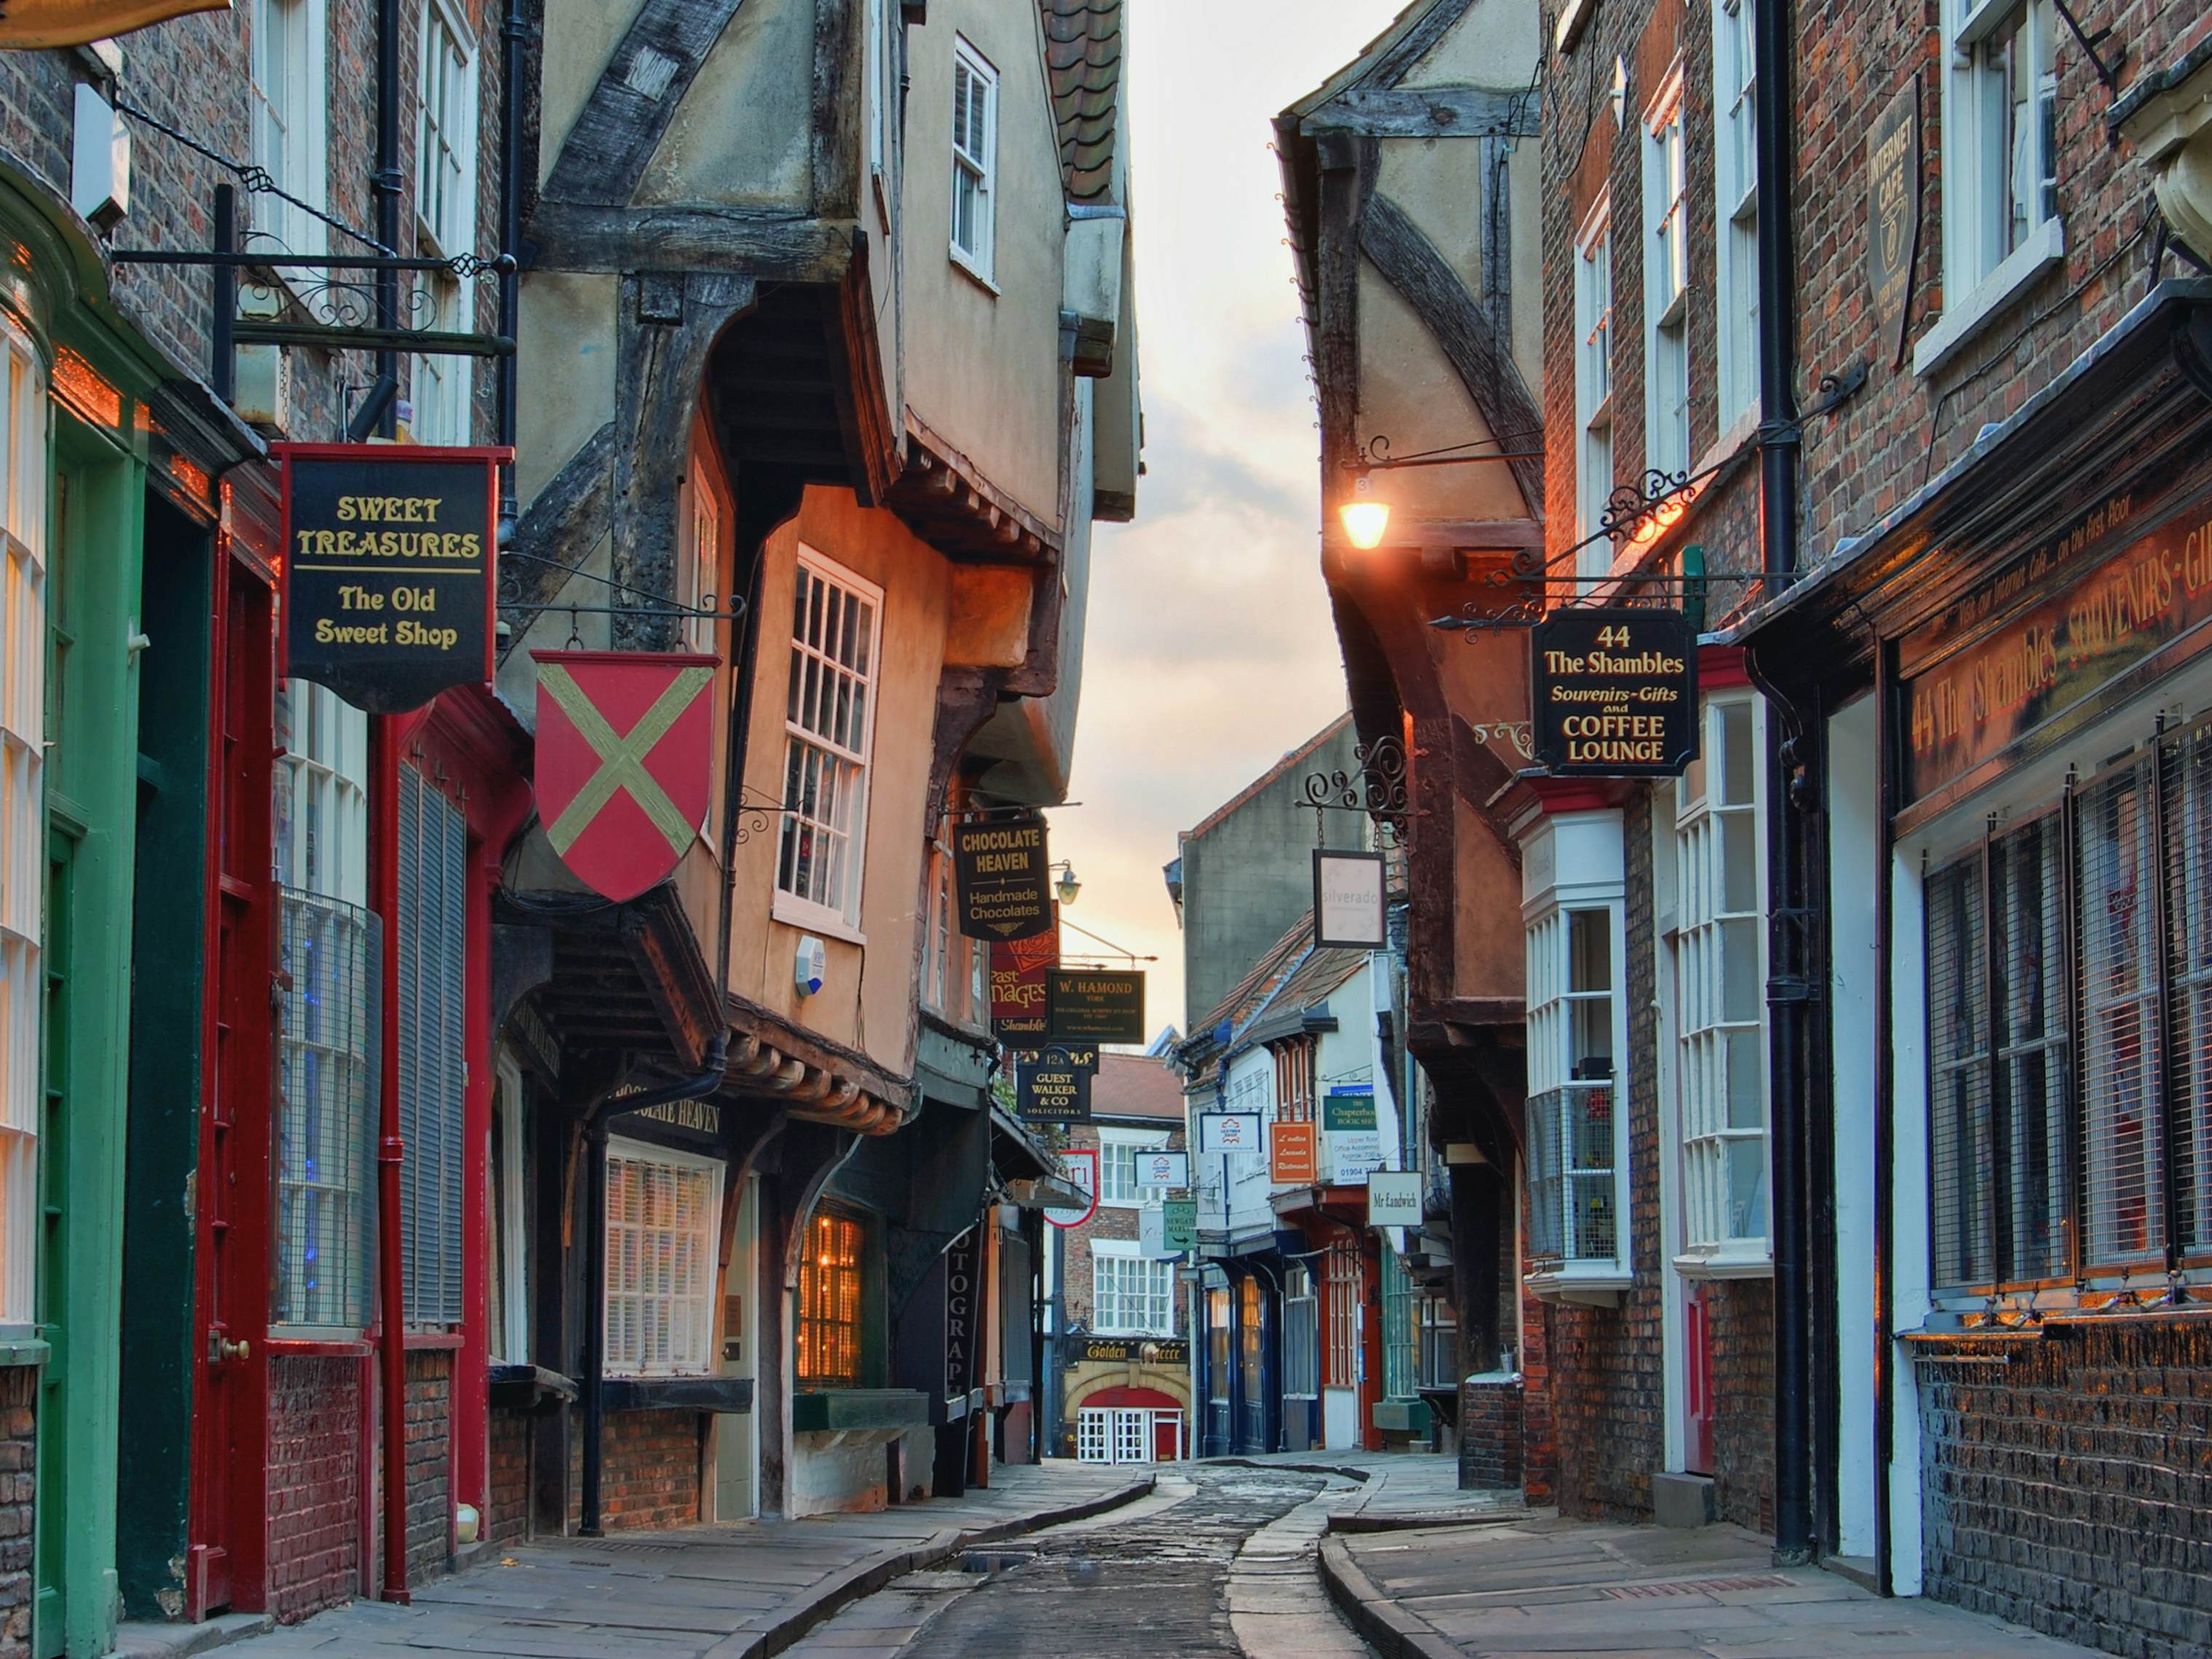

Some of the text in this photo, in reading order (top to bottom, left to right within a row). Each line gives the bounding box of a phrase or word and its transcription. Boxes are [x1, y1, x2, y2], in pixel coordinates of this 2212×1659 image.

[1871, 114, 1912, 186] INTERNET
[1879, 156, 1903, 211] CAFÉ
[336, 496, 443, 523] SWEET
[296, 529, 481, 558] TREASURES
[1994, 564, 2026, 605] Internet
[2071, 525, 2085, 553] the
[2108, 494, 2131, 528] floor
[339, 586, 435, 612] The Old
[315, 619, 457, 649] Sweet Shop
[1596, 625, 1630, 648] 44
[1544, 651, 1685, 673] The Shambles
[1603, 704, 1628, 713] and
[1563, 716, 1665, 737] COFFEE
[1912, 693, 1935, 753] 44
[1570, 741, 1664, 761] LOUNGE
[962, 828, 1040, 851] CHOCOLATE
[976, 852, 1029, 873] HEAVEN
[970, 888, 1038, 904] Handmade
[1323, 890, 1378, 904] silverado
[970, 904, 1040, 920] Chocolates
[991, 970, 1019, 983] Past
[1059, 980, 1133, 994] W. HAMOND
[1000, 1018, 1048, 1032] Shamble
[1036, 1073, 1073, 1083] GUEST
[1031, 1085, 1078, 1094] WALKER
[1040, 1096, 1069, 1106] & CO
[677, 1100, 720, 1134] HEAVEN
[1374, 1192, 1384, 1207] Mr
[1087, 1345, 1126, 1359] Golden
